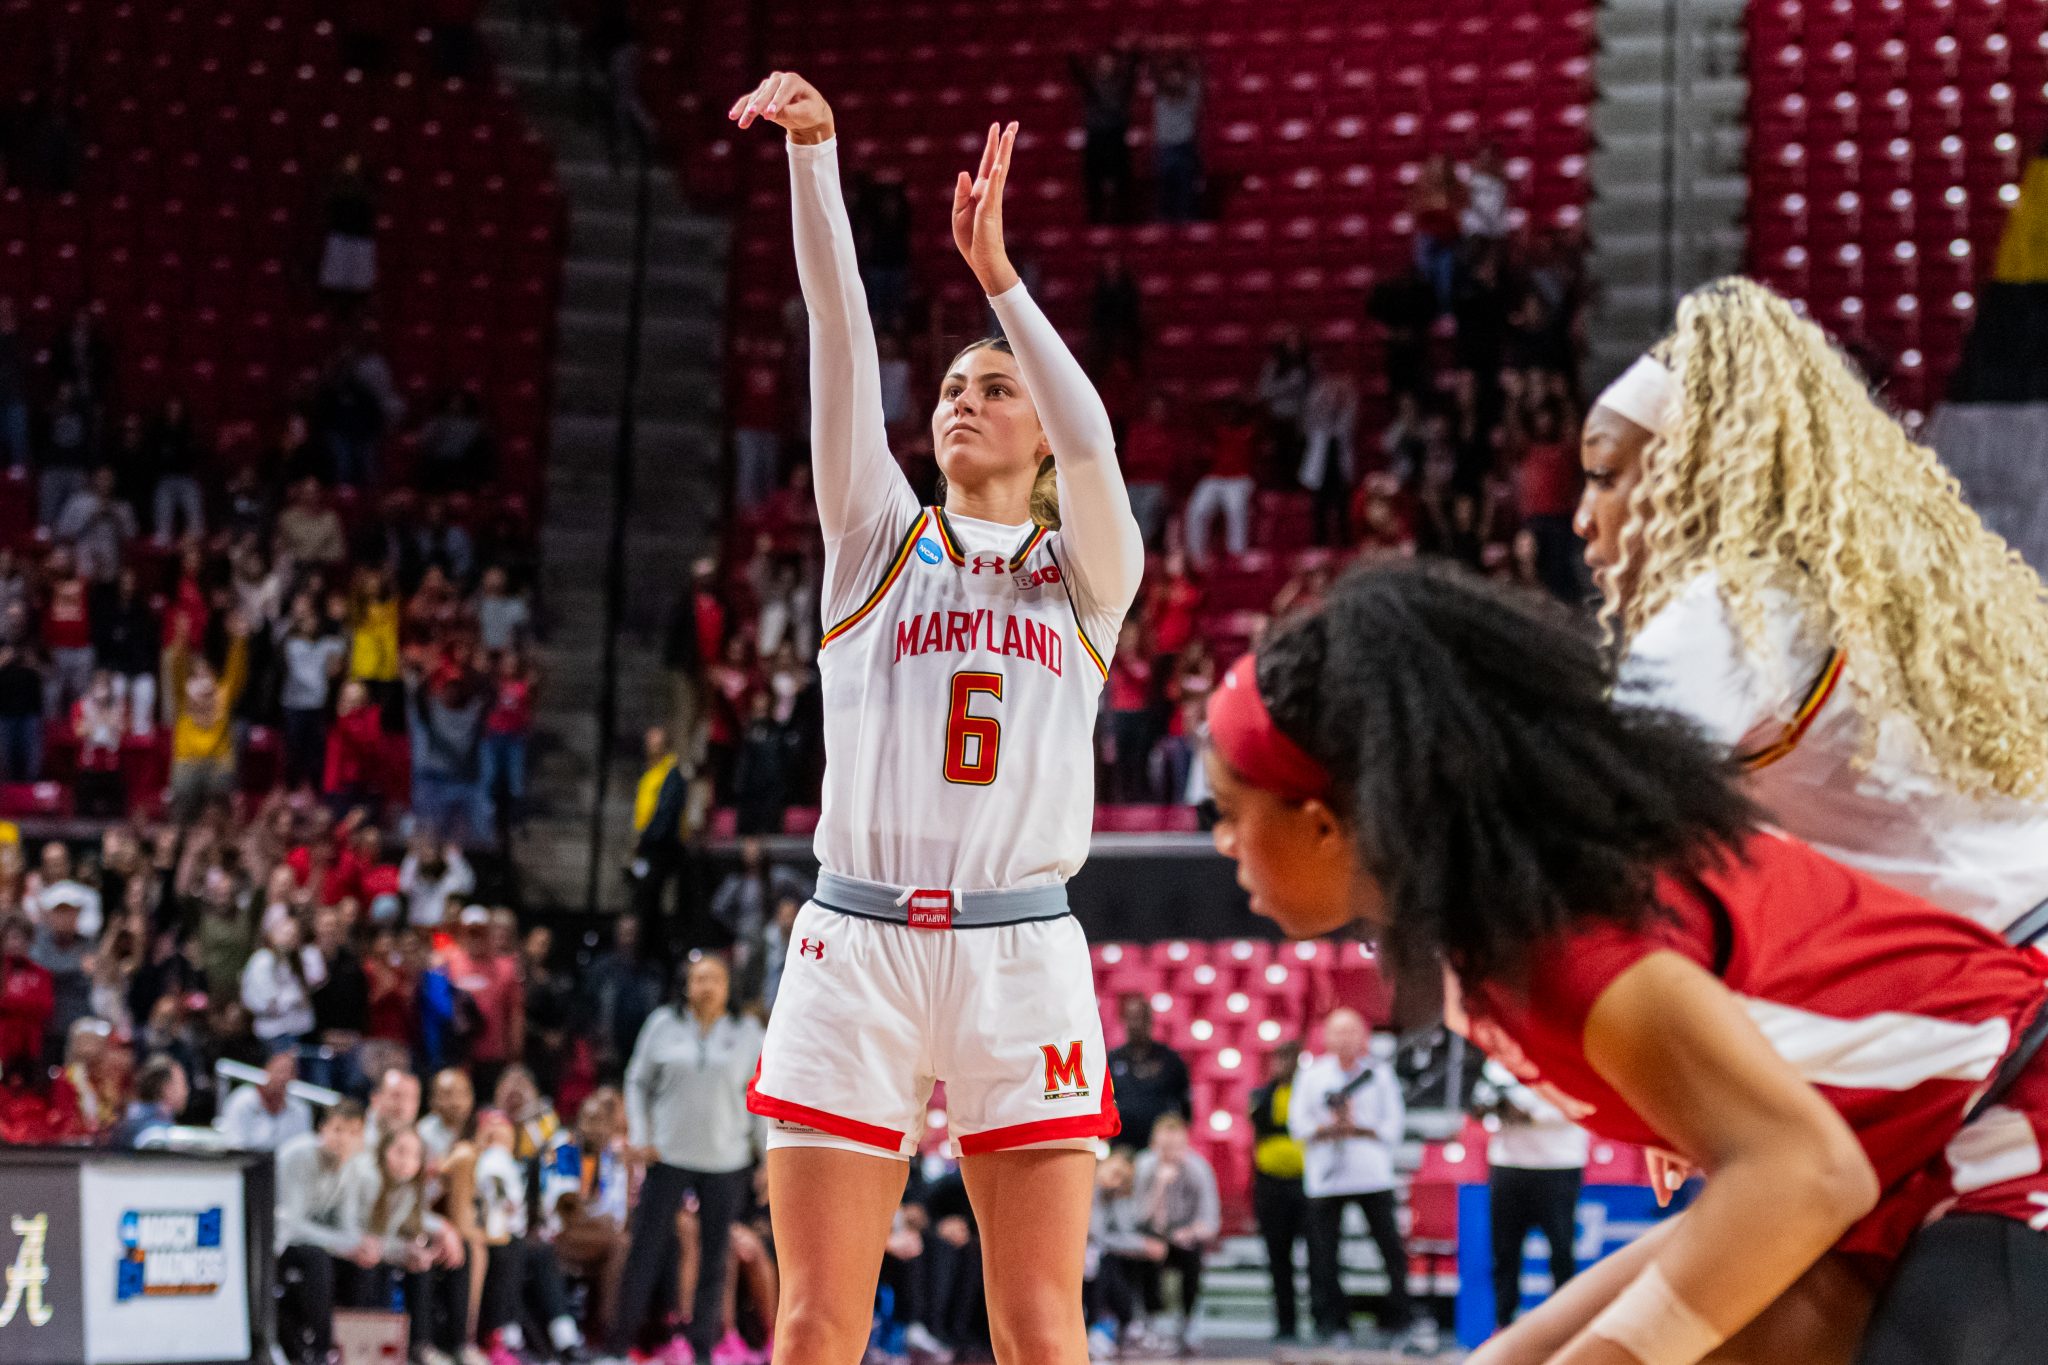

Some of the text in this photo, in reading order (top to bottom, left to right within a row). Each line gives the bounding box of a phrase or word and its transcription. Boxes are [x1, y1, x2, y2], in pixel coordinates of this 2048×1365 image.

[919, 544, 939, 562] NCAA
[894, 608, 1062, 678] MARYLAND
[943, 671, 1003, 786] 6
[912, 913, 946, 923] MARYLAND
[1039, 1040, 1088, 1092] M
